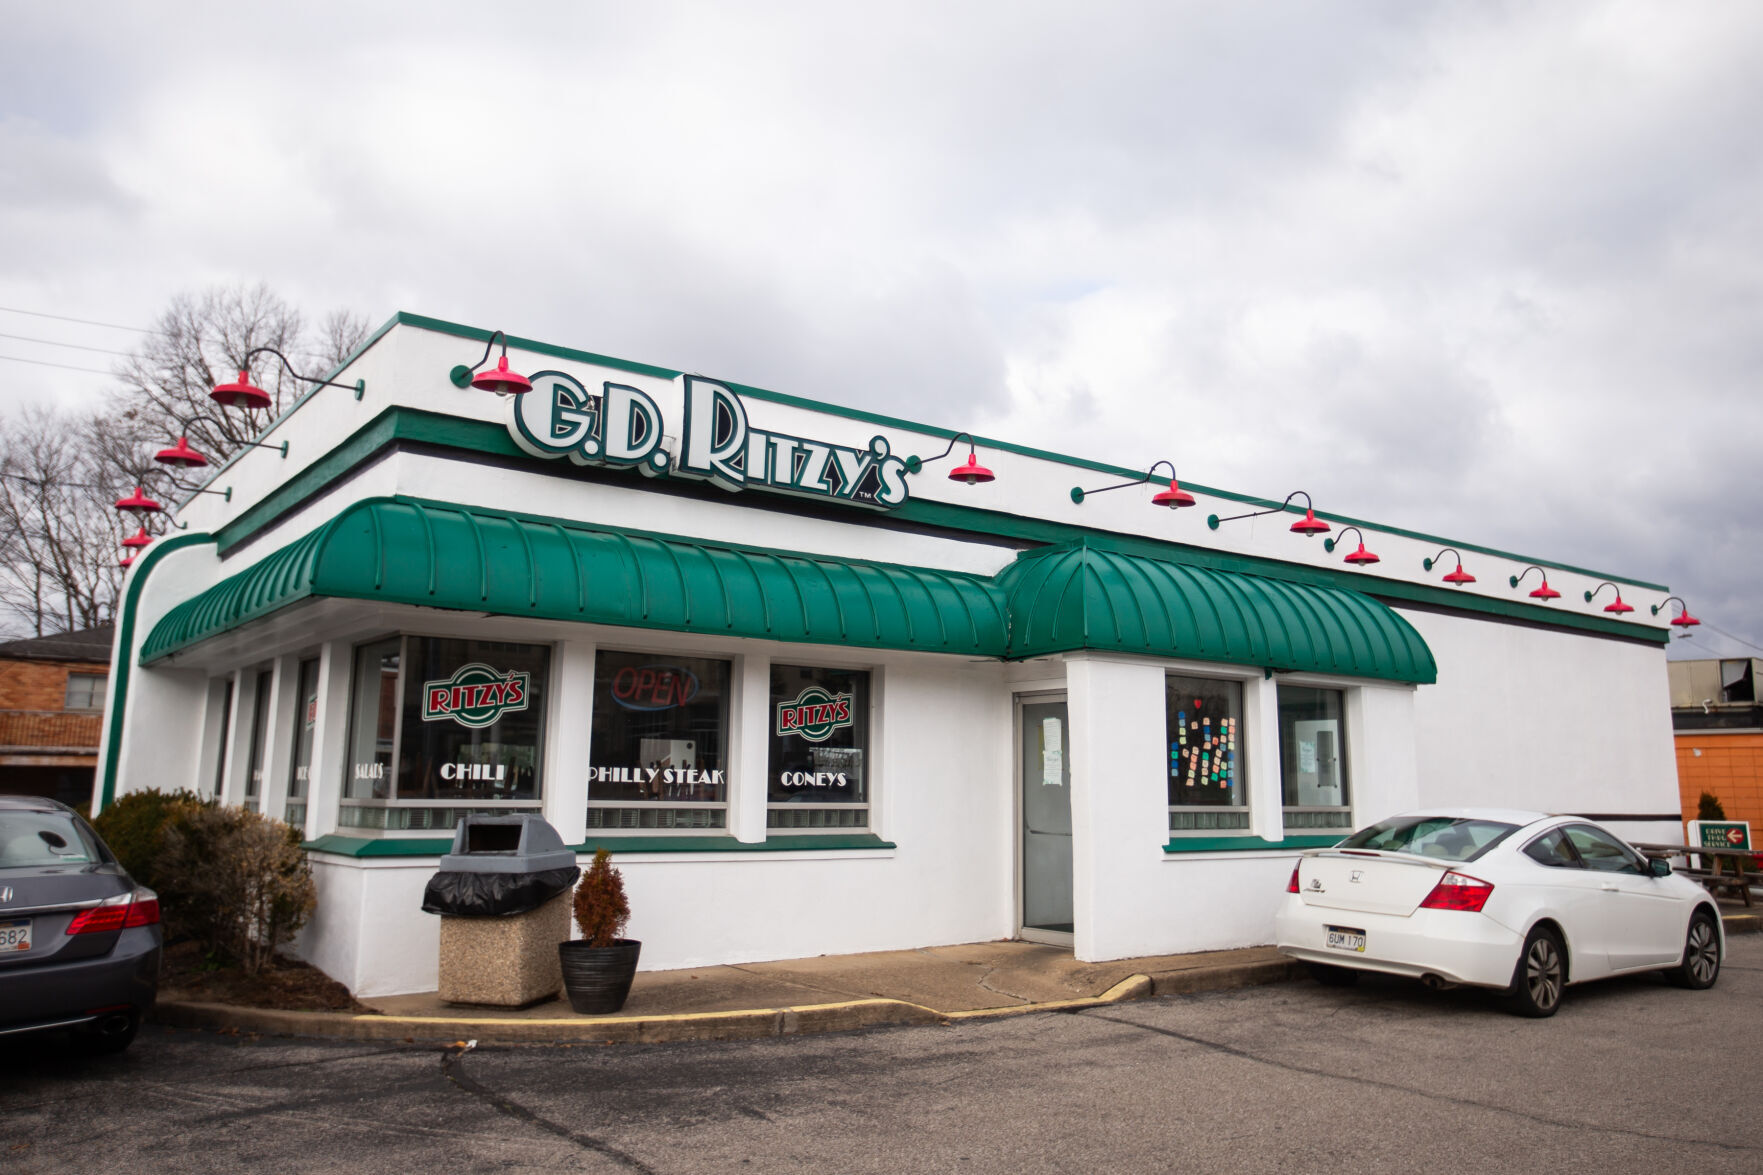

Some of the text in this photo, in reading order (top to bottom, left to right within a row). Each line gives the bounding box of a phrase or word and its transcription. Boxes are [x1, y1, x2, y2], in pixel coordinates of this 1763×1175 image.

[515, 370, 671, 474] G.D.
[859, 491, 872, 499] TM
[429, 673, 524, 714] RITZY'S
[613, 667, 691, 707] OPEN
[781, 695, 850, 730] RITZY'S
[355, 762, 384, 780] SALADS
[440, 762, 505, 780] CHILI
[663, 768, 725, 785] STEAK
[780, 771, 847, 788] CONEYS
